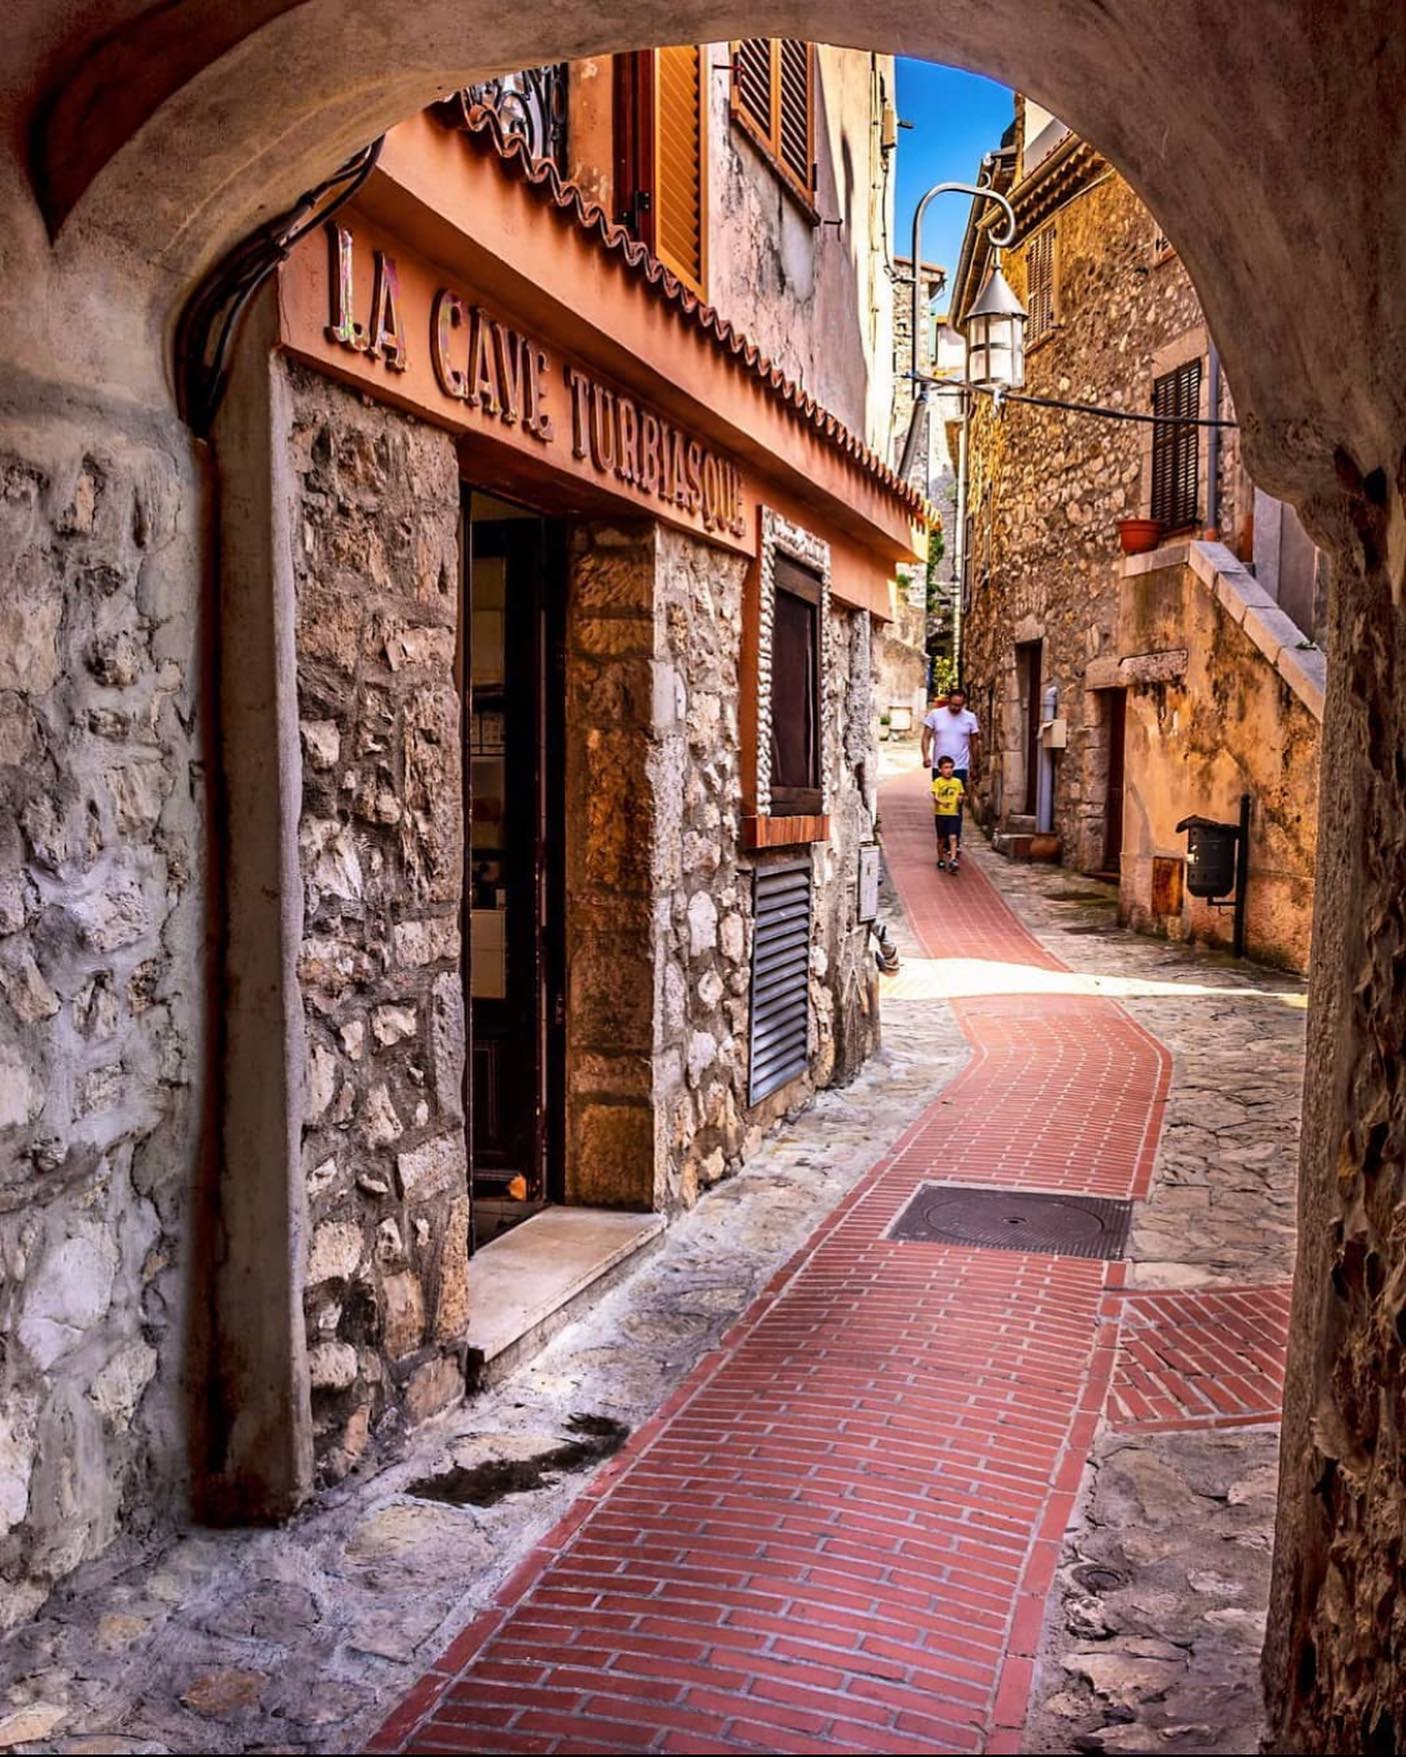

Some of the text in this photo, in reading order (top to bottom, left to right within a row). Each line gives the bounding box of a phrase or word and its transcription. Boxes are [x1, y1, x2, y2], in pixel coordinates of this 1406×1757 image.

[325, 222, 747, 538] LA CAVE TURBIASQUE
